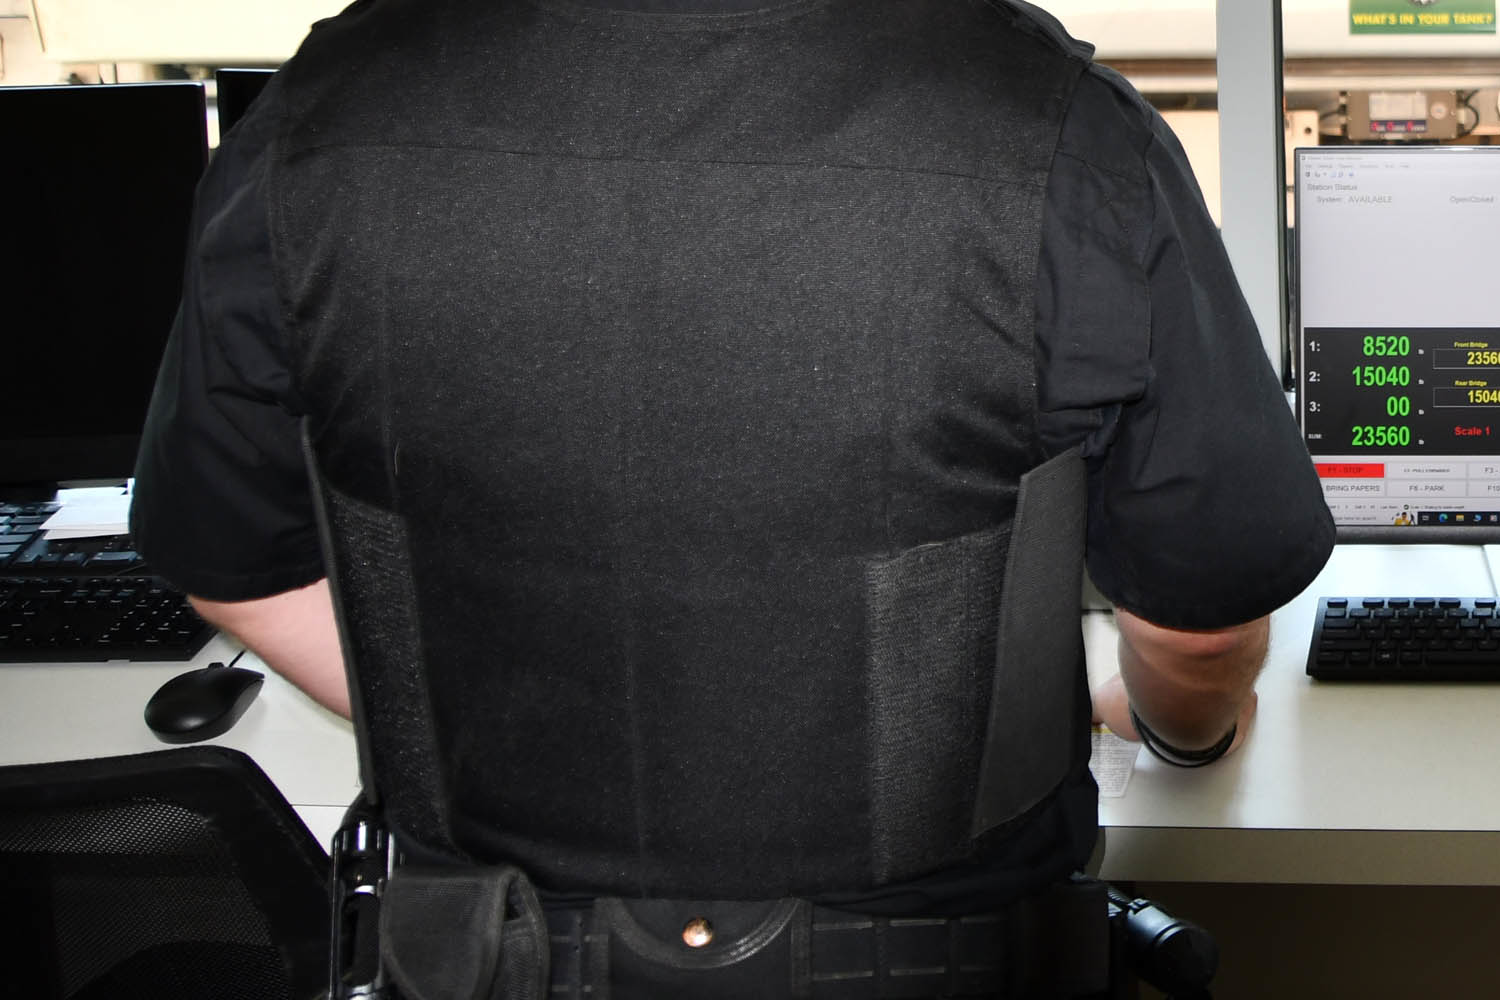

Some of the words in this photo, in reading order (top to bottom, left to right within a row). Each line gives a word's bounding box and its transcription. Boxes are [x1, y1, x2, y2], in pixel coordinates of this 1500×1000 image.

[1352, 13, 1397, 25] WHAT'S
[1400, 13, 1414, 25] IN
[1417, 13, 1450, 25] YOUR
[1453, 13, 1493, 25] TANK?
[1308, 341, 1321, 352] 1:
[1363, 335, 1410, 356] 8520
[1308, 371, 1321, 382] 2:
[1352, 366, 1410, 386] 15040
[1308, 401, 1321, 412] 3:
[1386, 396, 1410, 416] 00
[1352, 426, 1410, 446] 23560
[1454, 426, 1483, 436] Scale
[1485, 425, 1491, 435] 1
